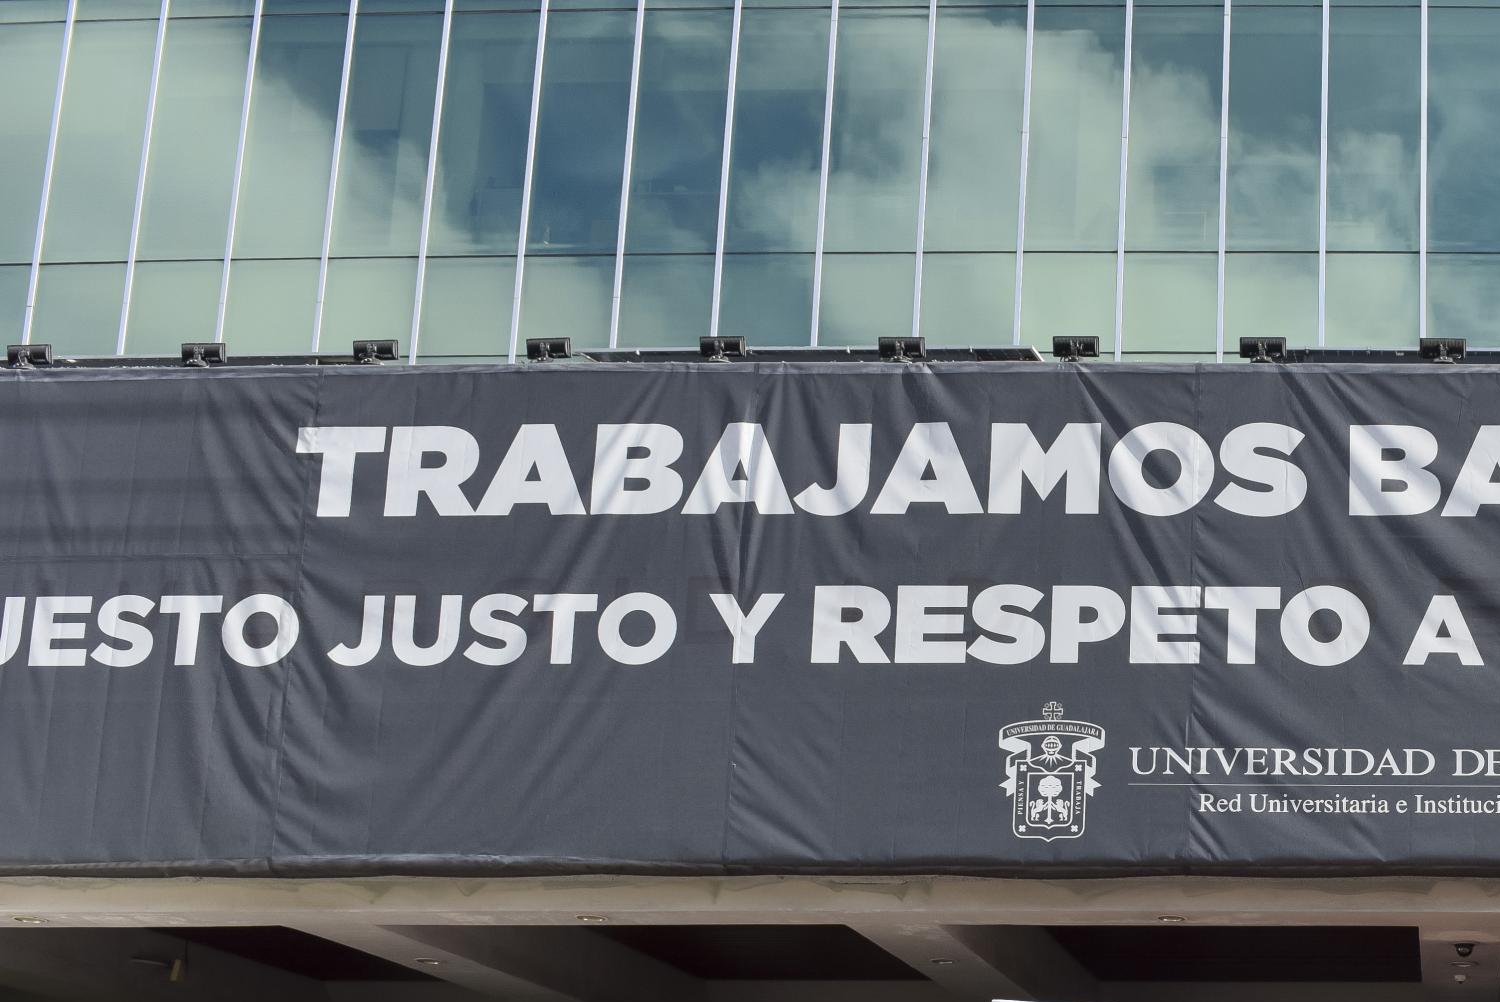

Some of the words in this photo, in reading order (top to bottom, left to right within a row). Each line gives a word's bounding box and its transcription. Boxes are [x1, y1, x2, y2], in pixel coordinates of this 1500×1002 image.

[295, 421, 1308, 519] TRABAJAMOS
[328, 592, 677, 667] JUSTO
[710, 592, 784, 664] Y
[811, 584, 1371, 667] RESPETO
[1402, 595, 1485, 666] A
[1006, 723, 1047, 737] UNIVERSIDAD
[1047, 723, 1057, 732] DE
[1056, 723, 1099, 737] GUADALAJARA
[1129, 746, 1436, 778] UNIVERSIDAD
[1199, 794, 1242, 815] Red
[1247, 794, 1390, 815] Universitaria
[1395, 801, 1408, 815] e
